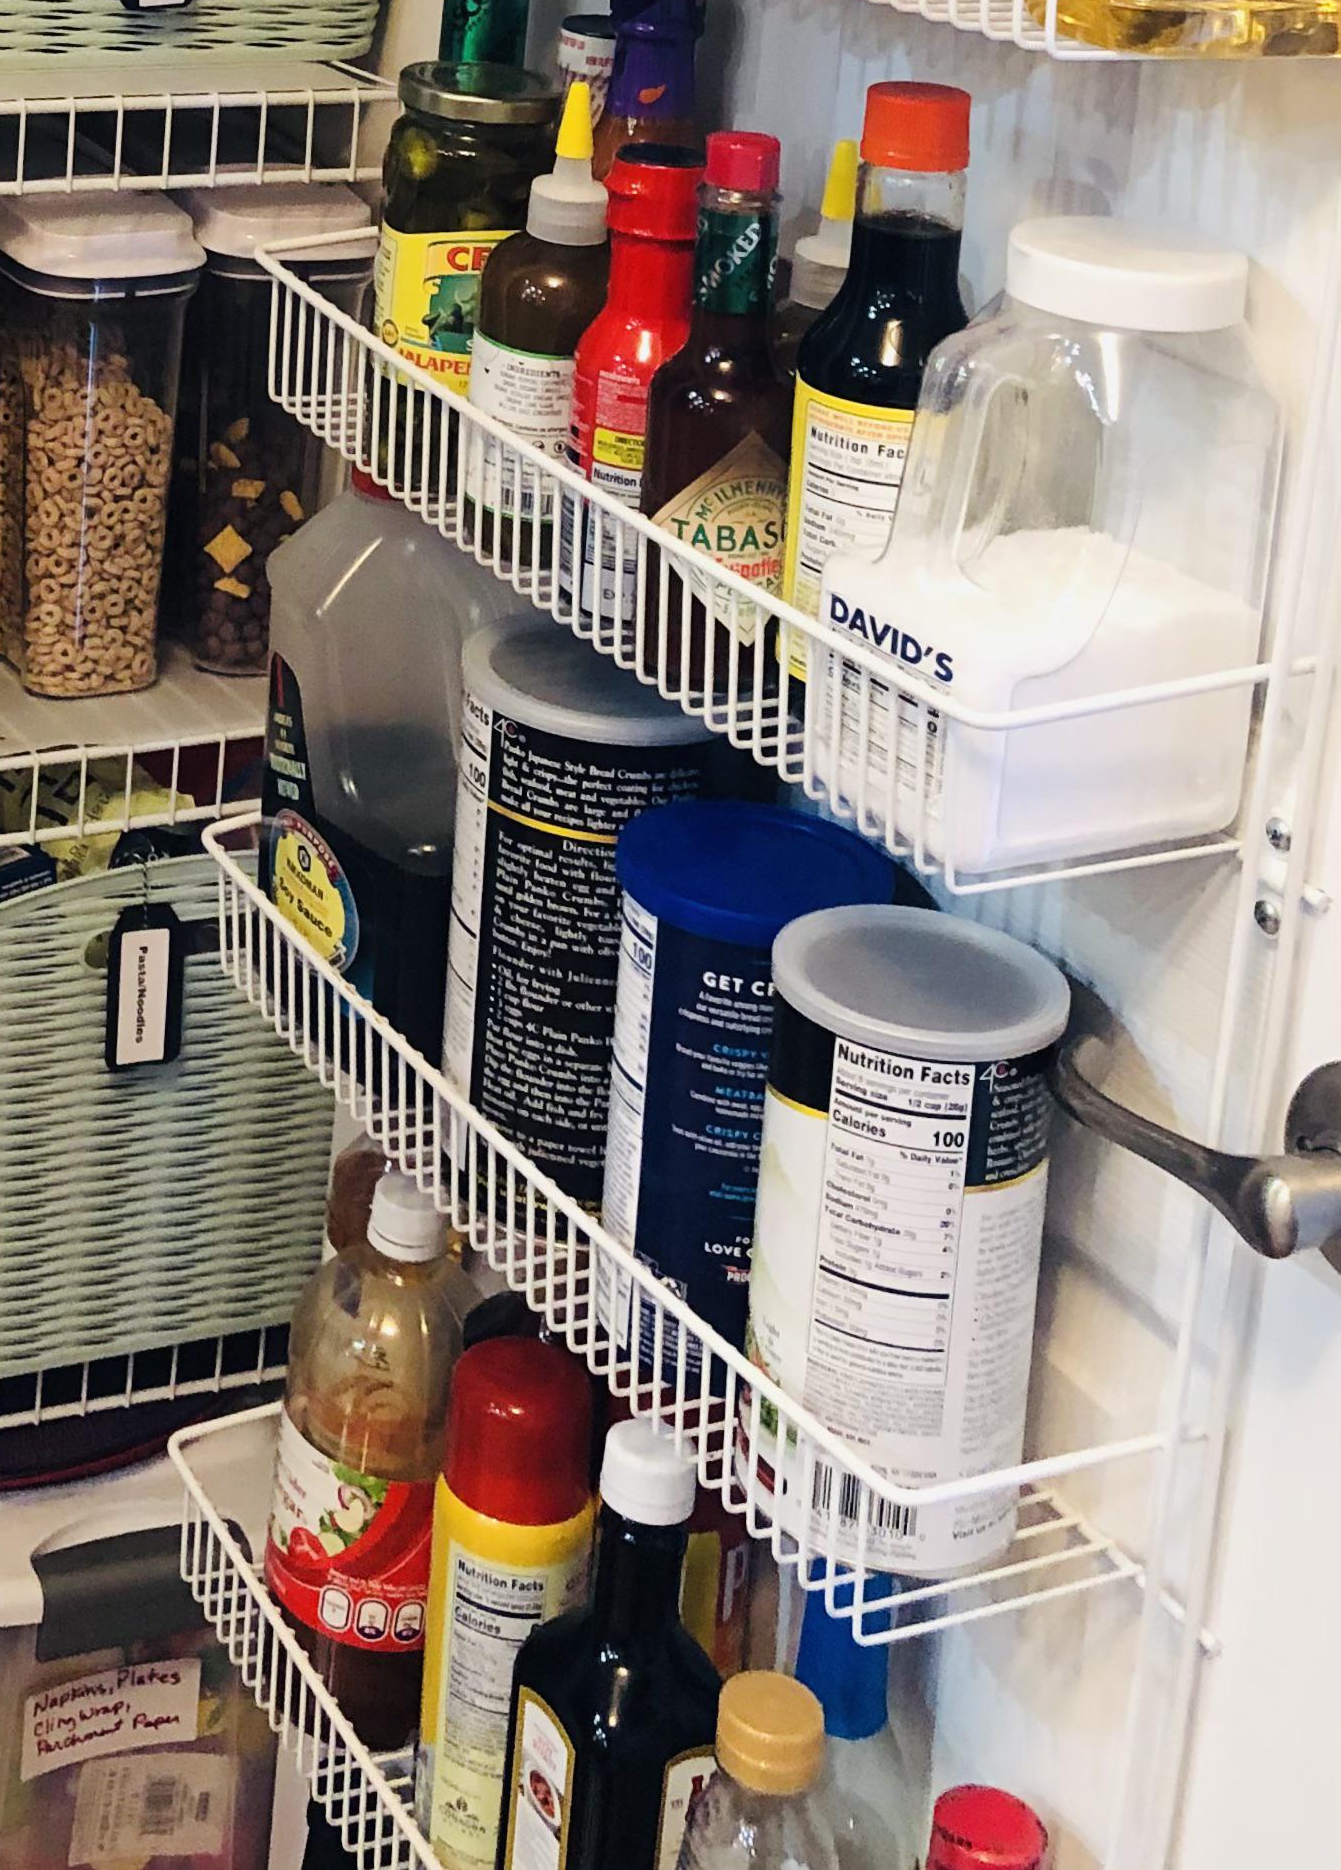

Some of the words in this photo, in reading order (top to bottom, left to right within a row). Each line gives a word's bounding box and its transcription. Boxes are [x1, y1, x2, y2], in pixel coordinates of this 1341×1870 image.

[810, 426, 869, 454] Nutrition
[593, 467, 637, 488] Nutrition
[829, 592, 954, 683] DAVID'S
[468, 762, 487, 788] 100
[564, 760, 587, 775] Style
[589, 765, 615, 779] Bread
[617, 768, 652, 781] Crumbs
[278, 876, 295, 906] Soy
[297, 895, 334, 939] Sauce
[134, 945, 149, 1045] Pasta/Noodles
[702, 971, 744, 995] GET
[837, 1042, 915, 1081] Nutrition
[920, 1066, 971, 1086] Facts
[835, 1075, 868, 1097] Serving
[870, 1090, 889, 1101] size
[924, 1101, 942, 1112] cup
[833, 1096, 863, 1114] Amount
[880, 1114, 912, 1128] serving
[832, 1108, 887, 1139] Calories
[932, 1130, 965, 1148] 100
[910, 1152, 932, 1164] Daily
[824, 1204, 844, 1220] Total
[844, 1213, 901, 1236] Carbohydrate
[703, 1241, 742, 1258] LOVE
[457, 1558, 508, 1590] Nutrition
[511, 1577, 545, 1593] Facts
[454, 1605, 502, 1636] Calories
[32, 1682, 115, 1718] Napkins,
[117, 1667, 182, 1690] Plates
[78, 1699, 132, 1722] Wrap,
[132, 1712, 181, 1731] Paper
